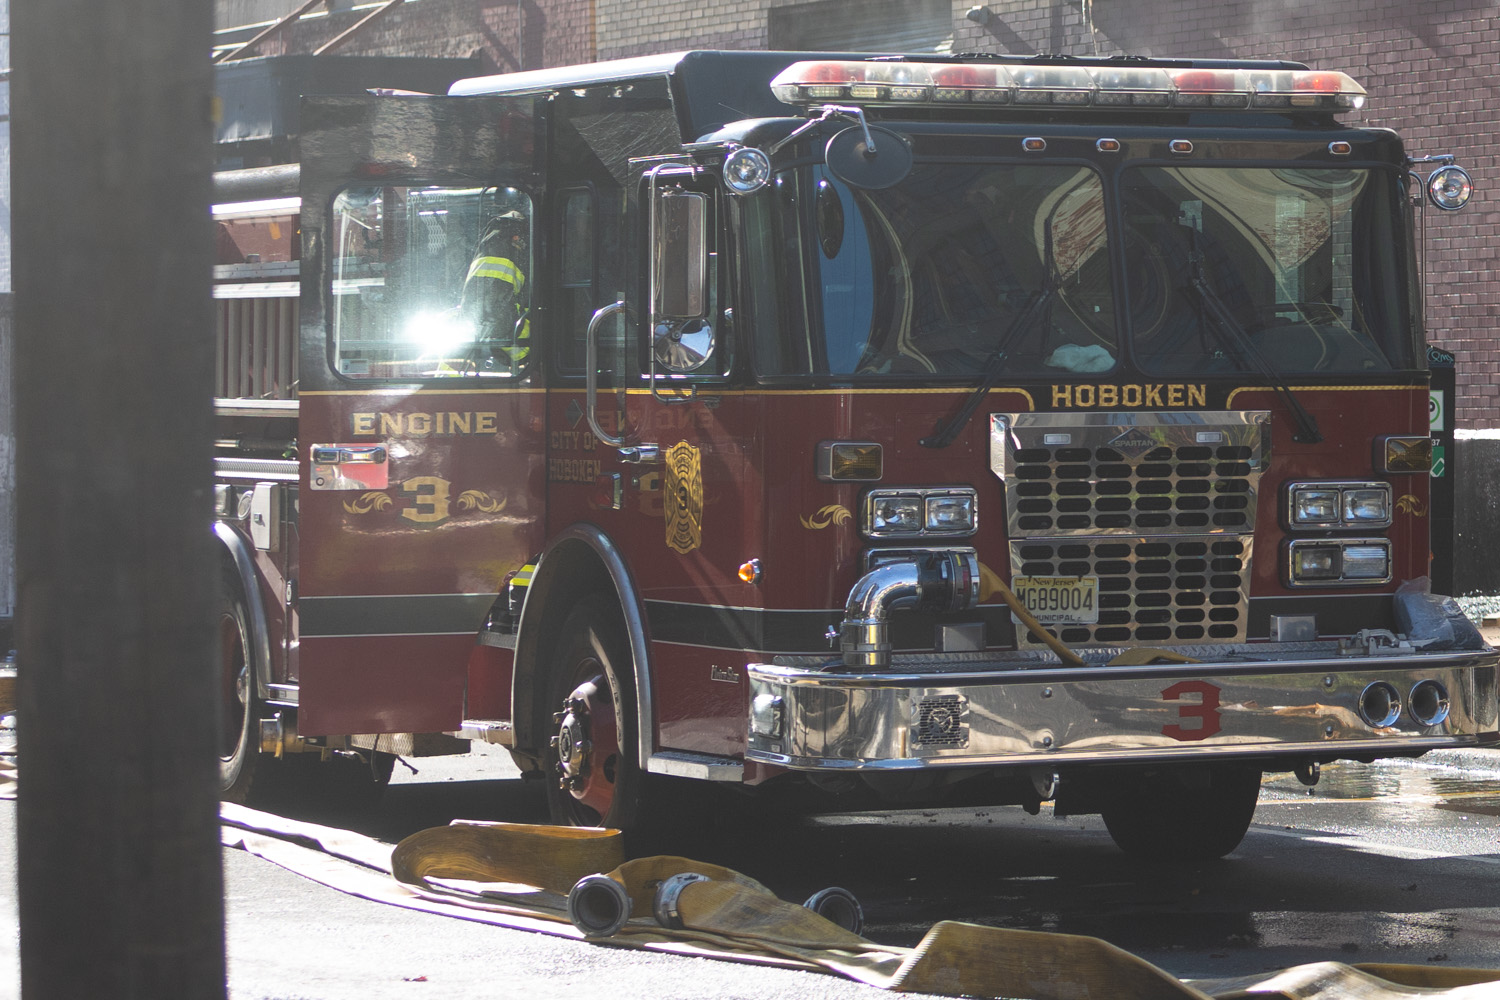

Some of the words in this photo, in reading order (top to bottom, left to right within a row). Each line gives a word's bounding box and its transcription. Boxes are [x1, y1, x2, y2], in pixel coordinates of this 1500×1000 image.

[1051, 384, 1207, 407] HOBOKEN
[353, 412, 498, 435] ENGINE
[551, 431, 580, 450] CITY
[1114, 439, 1154, 447] SPARTAN
[550, 458, 601, 483] HOBOKEN
[402, 476, 452, 523] 3
[1033, 578, 1050, 586] New
[1052, 577, 1076, 587] Jersey
[1016, 587, 1093, 611] MG89004
[1161, 680, 1222, 741] 3
